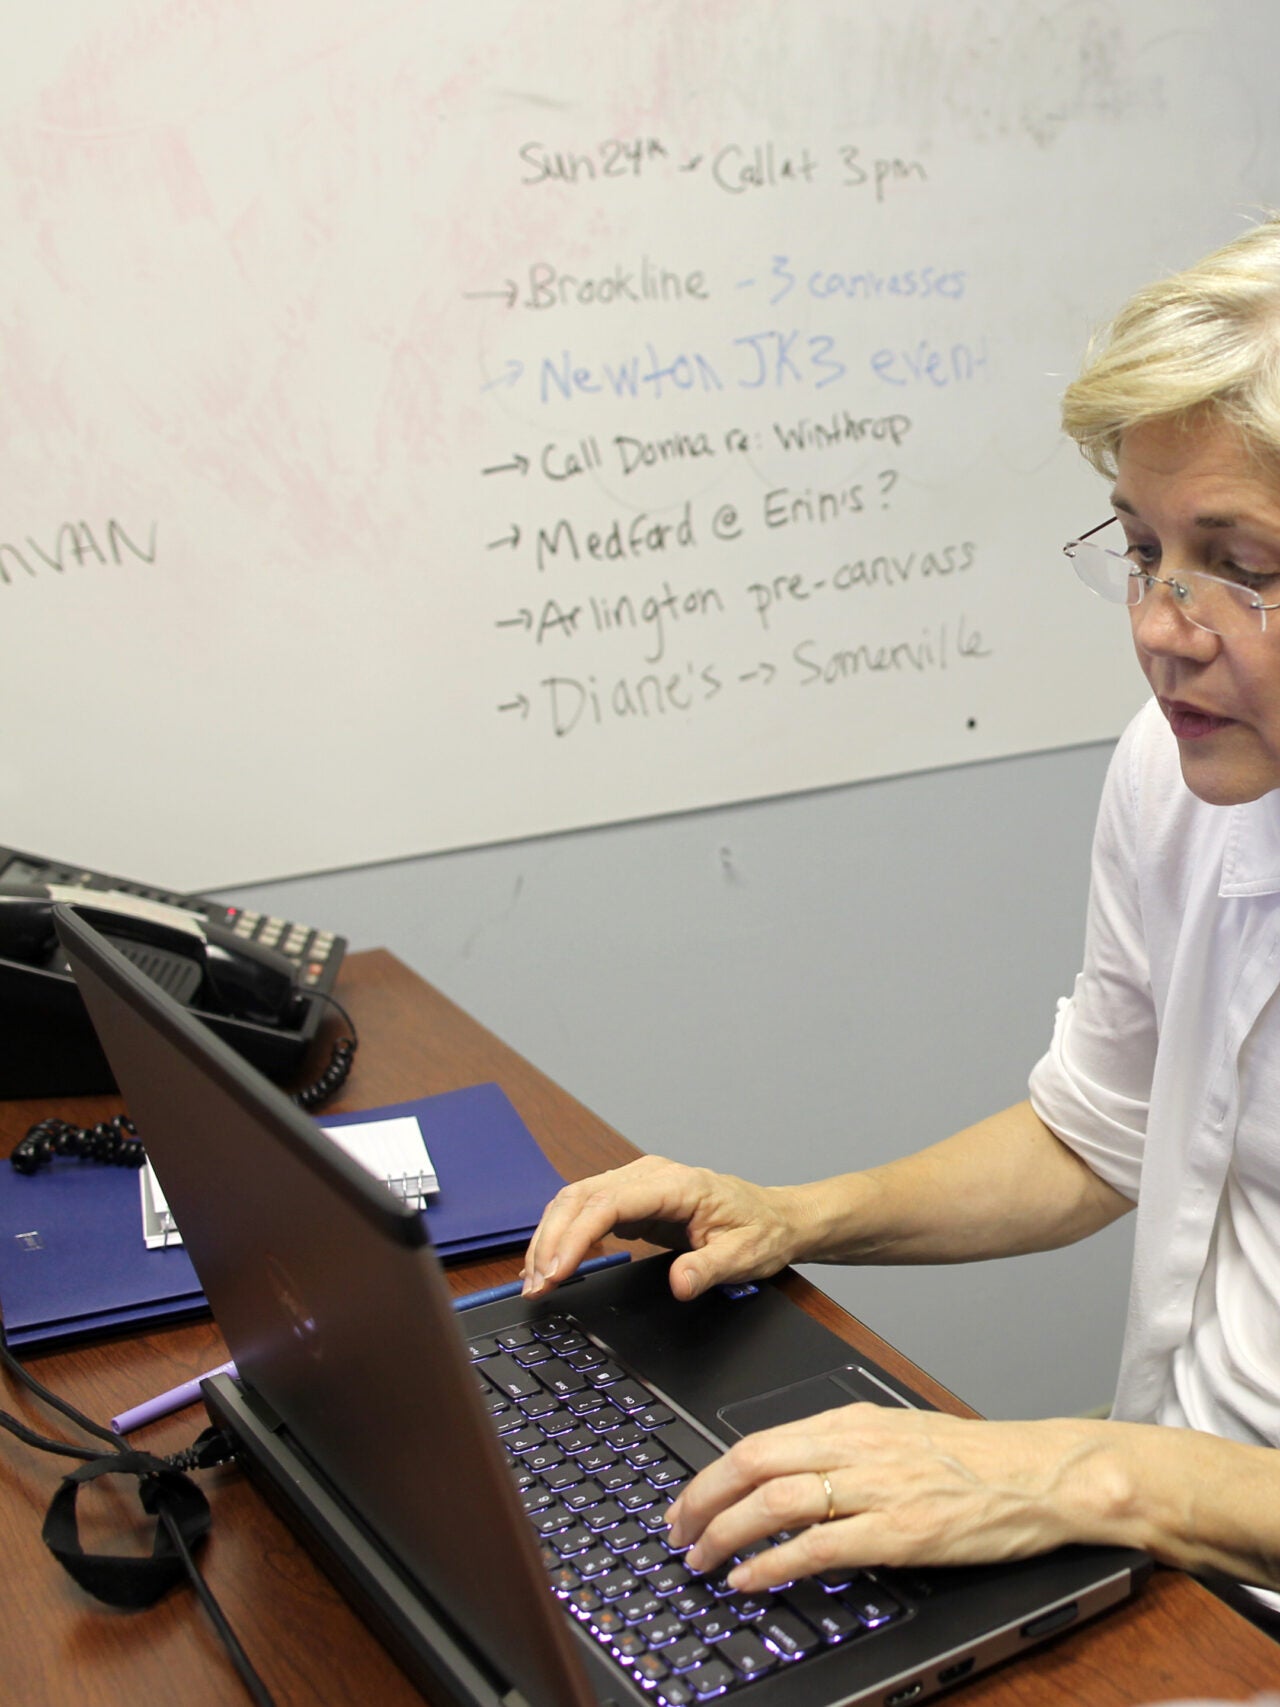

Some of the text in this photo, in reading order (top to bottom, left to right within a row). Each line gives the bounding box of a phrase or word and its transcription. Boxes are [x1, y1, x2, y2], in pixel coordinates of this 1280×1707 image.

[841, 145, 868, 187] 3
[875, 160, 929, 202] pm
[524, 256, 710, 309] Brookline
[540, 343, 725, 403] Newton
[541, 437, 602, 482] Call
[614, 430, 715, 475] Donna
[773, 411, 912, 454] Winthrop
[535, 502, 697, 570] Medford
[535, 541, 976, 663] Arlington pre-canvass
[541, 613, 995, 738] Diane's Somerville
